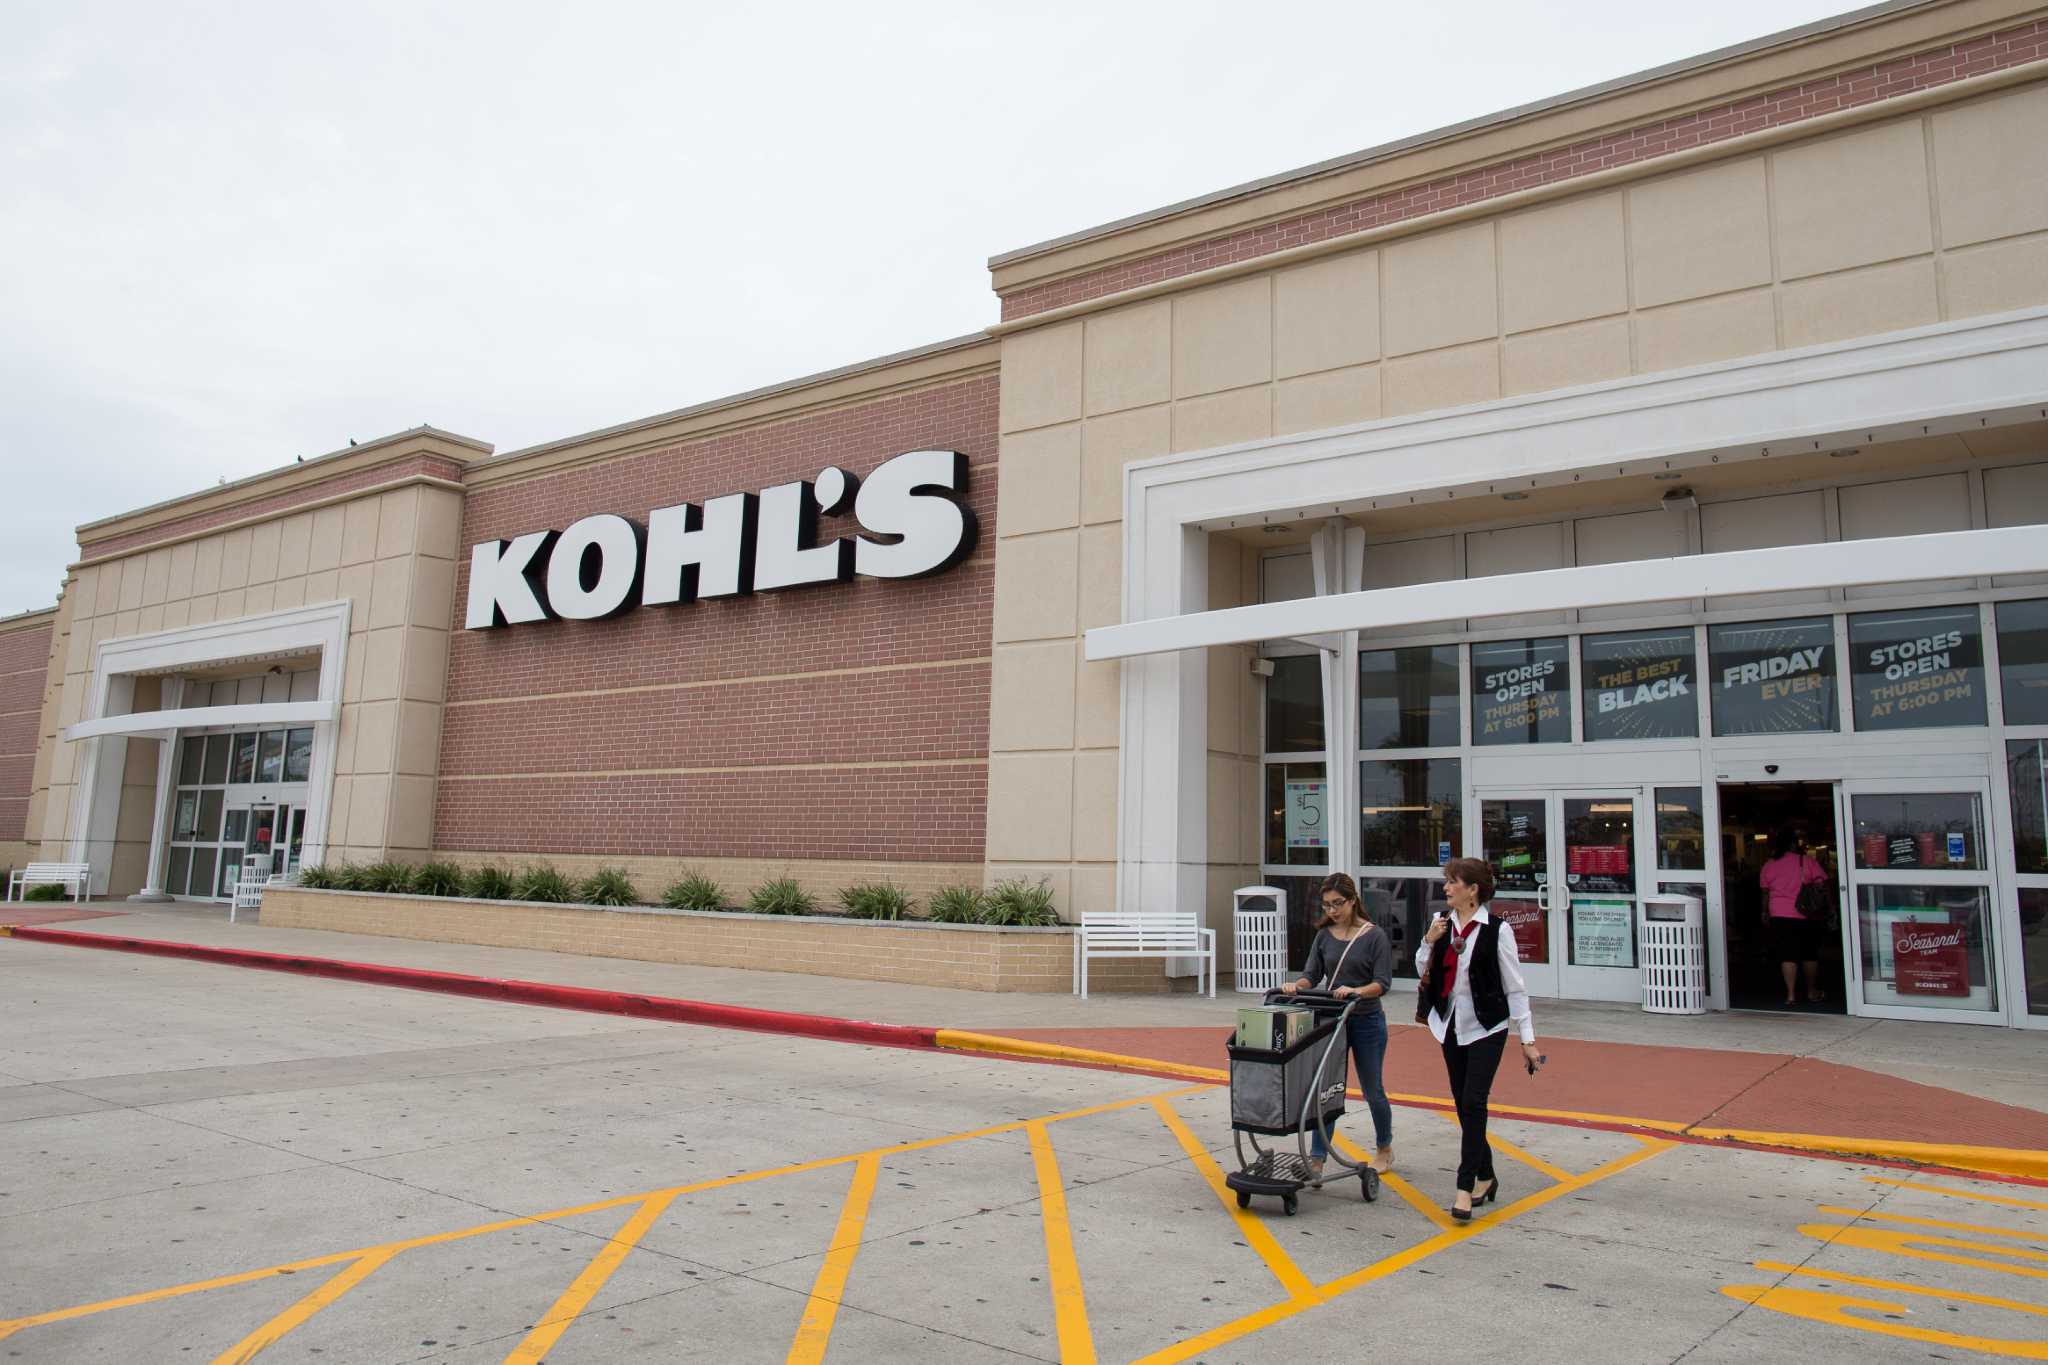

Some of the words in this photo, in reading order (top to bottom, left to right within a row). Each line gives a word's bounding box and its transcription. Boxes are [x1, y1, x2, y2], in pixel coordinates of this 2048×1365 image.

[464, 450, 976, 631] KOHL'S
[1870, 630, 1962, 666] STORES
[1485, 660, 1555, 689] STORES
[1599, 670, 1633, 689] THE
[1636, 658, 1681, 681] BEST
[1723, 646, 1824, 688] FRIDAY
[1885, 652, 1950, 680] OPEN
[1495, 678, 1545, 702] OPEN
[1599, 674, 1690, 713] BLACK
[1761, 673, 1822, 700] EVER
[1871, 668, 1968, 700] THURSDAY
[1484, 693, 1557, 720] THURSDAY
[1871, 702, 1895, 718] AT
[1899, 692, 1940, 712] 6:00
[1944, 684, 1971, 699] PM
[1484, 721, 1500, 734] AT
[1504, 711, 1536, 729] 6:00
[1538, 707, 1560, 719] PM
[1896, 929, 1960, 953] Seasonal
[1920, 948, 1937, 956] TEAM
